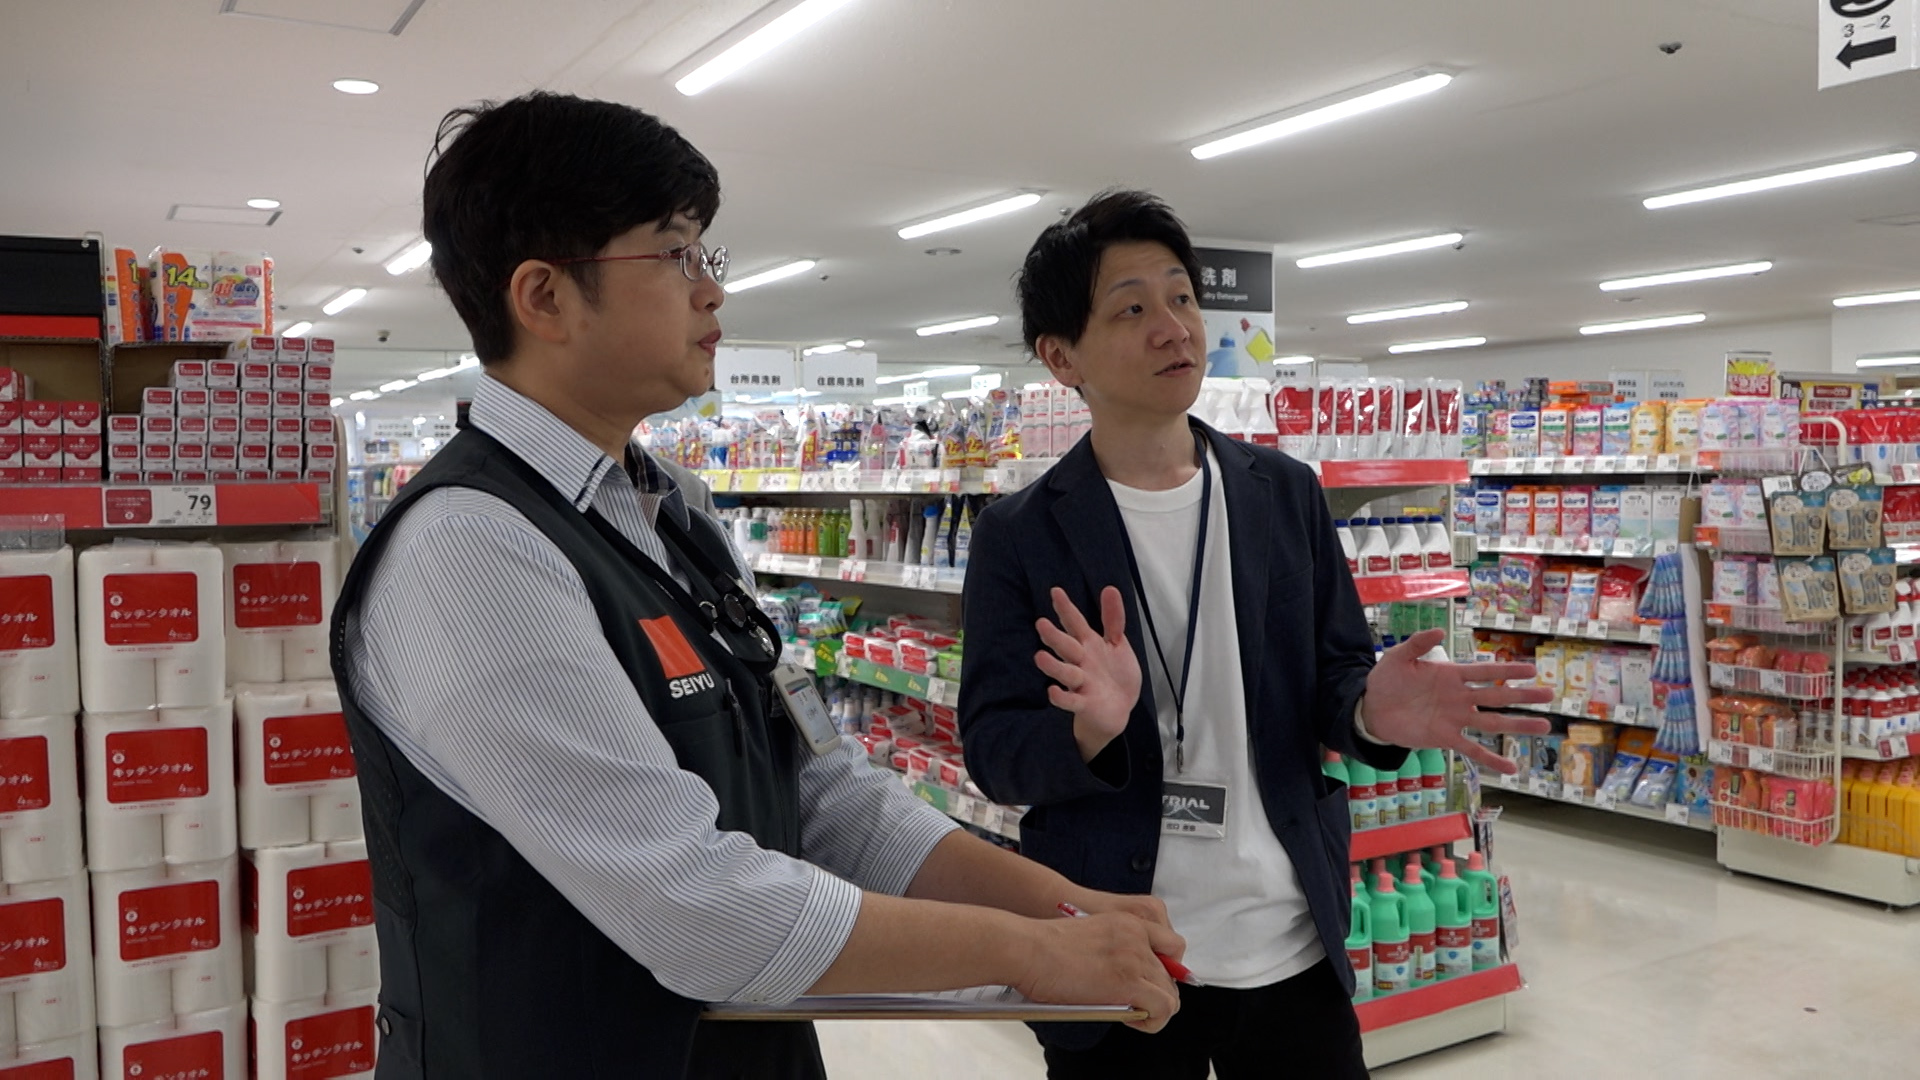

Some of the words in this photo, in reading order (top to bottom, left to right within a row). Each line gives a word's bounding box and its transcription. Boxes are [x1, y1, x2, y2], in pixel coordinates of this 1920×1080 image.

[187, 494, 212, 511] 79
[240, 594, 309, 606] キッチンタオル
[1, 613, 38, 625] タオル
[110, 607, 192, 620] キッチンタオル
[669, 672, 715, 699] SEIYU
[270, 745, 344, 761] キッチンタオル
[112, 763, 194, 778] キッチンタオル
[293, 893, 365, 913] キッチンタオル
[126, 917, 206, 936] キッチンタオル
[291, 1041, 363, 1063] キッチンタオル
